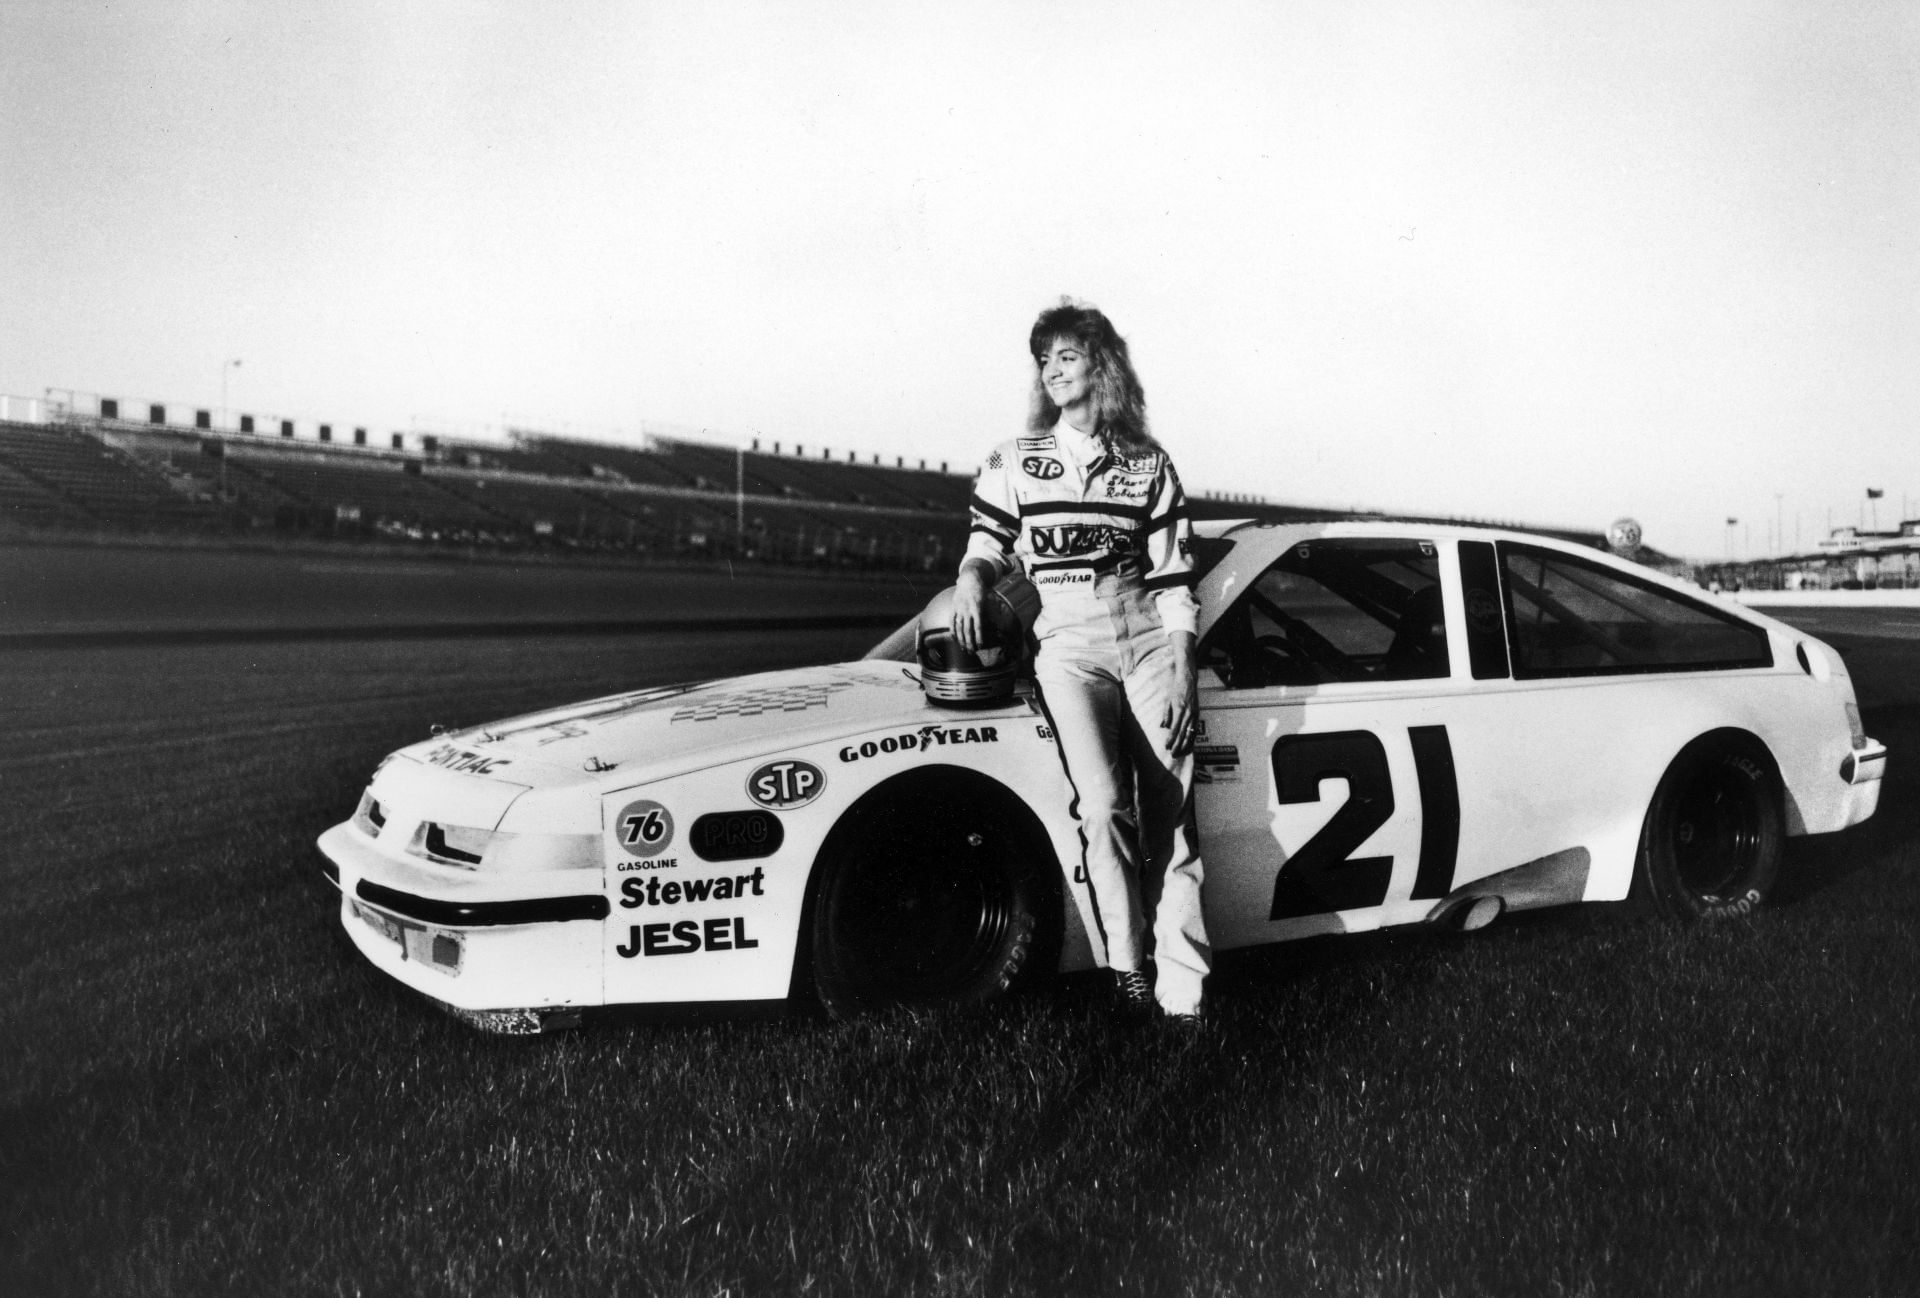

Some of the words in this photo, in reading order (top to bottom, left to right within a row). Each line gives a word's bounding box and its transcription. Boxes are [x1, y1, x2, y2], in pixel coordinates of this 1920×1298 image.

[1025, 458, 1063, 477] STP
[1105, 487, 1149, 498] Robinso
[1039, 573, 1091, 585] GOODYEAR
[839, 726, 999, 763] GOODYEAR
[1036, 725, 1053, 739] Ga
[756, 763, 815, 801] STP
[623, 811, 666, 844] 76
[705, 814, 768, 847] PRO
[1269, 724, 1461, 921] 21
[617, 858, 678, 872] GASOLINE
[619, 867, 765, 908] Stewart
[616, 917, 759, 959] JESEL
